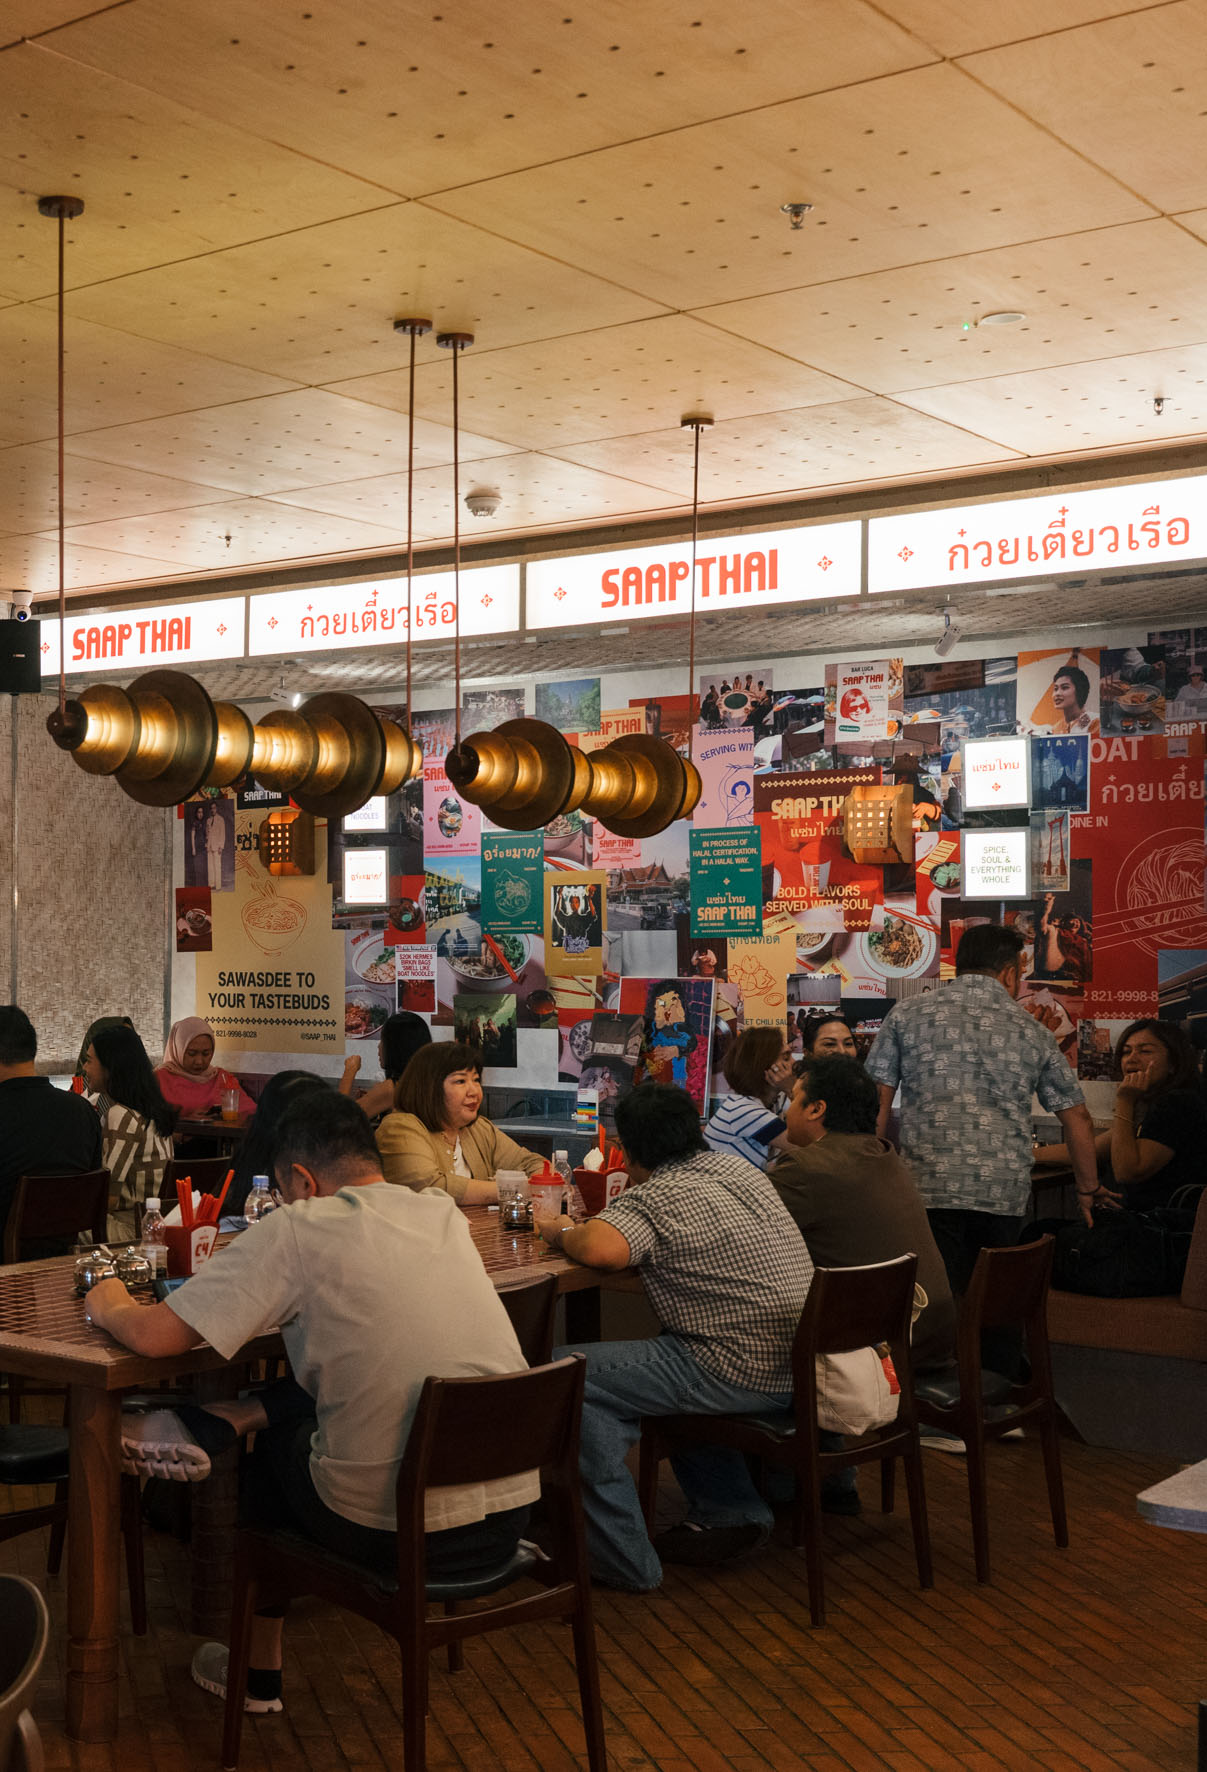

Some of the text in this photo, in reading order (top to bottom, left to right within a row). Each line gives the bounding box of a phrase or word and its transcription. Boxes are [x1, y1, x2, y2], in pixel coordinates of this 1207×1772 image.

[948, 505, 1190, 571] ก๋วยเตี๋ยวเรือ
[601, 549, 778, 608] SAAP THAI
[300, 589, 457, 638] ก๋วยเตี๋ยวเรือ
[72, 616, 191, 661] SAAP THAI
[842, 674, 884, 686] SAAP THAI
[614, 718, 641, 734] THAI
[1162, 721, 1207, 737] SAAP T
[700, 743, 754, 761] SERVING WIT
[1090, 736, 1144, 763] OAT
[1102, 764, 1205, 804] ก๋วยเตี๋ย
[244, 791, 264, 802] SAAP
[771, 795, 845, 820] SAAP TH
[1096, 815, 1108, 827] IN
[710, 839, 738, 847] PROCESS
[715, 857, 734, 865] HALAL
[981, 855, 1011, 864] SOUL &
[971, 865, 1022, 874] EVERYTHING
[981, 875, 1011, 884] WHOLE
[777, 885, 861, 899] BOLD FLAVORS
[697, 905, 757, 921] SAAP THAI
[766, 900, 808, 912] SERVED
[841, 898, 872, 911] SOUL
[218, 971, 316, 988] SAWASDEE TO
[208, 992, 331, 1011] YOUR TASTEBUDS
[1091, 990, 1159, 1002] 821-9998-8
[755, 1018, 774, 1026] CHILI
